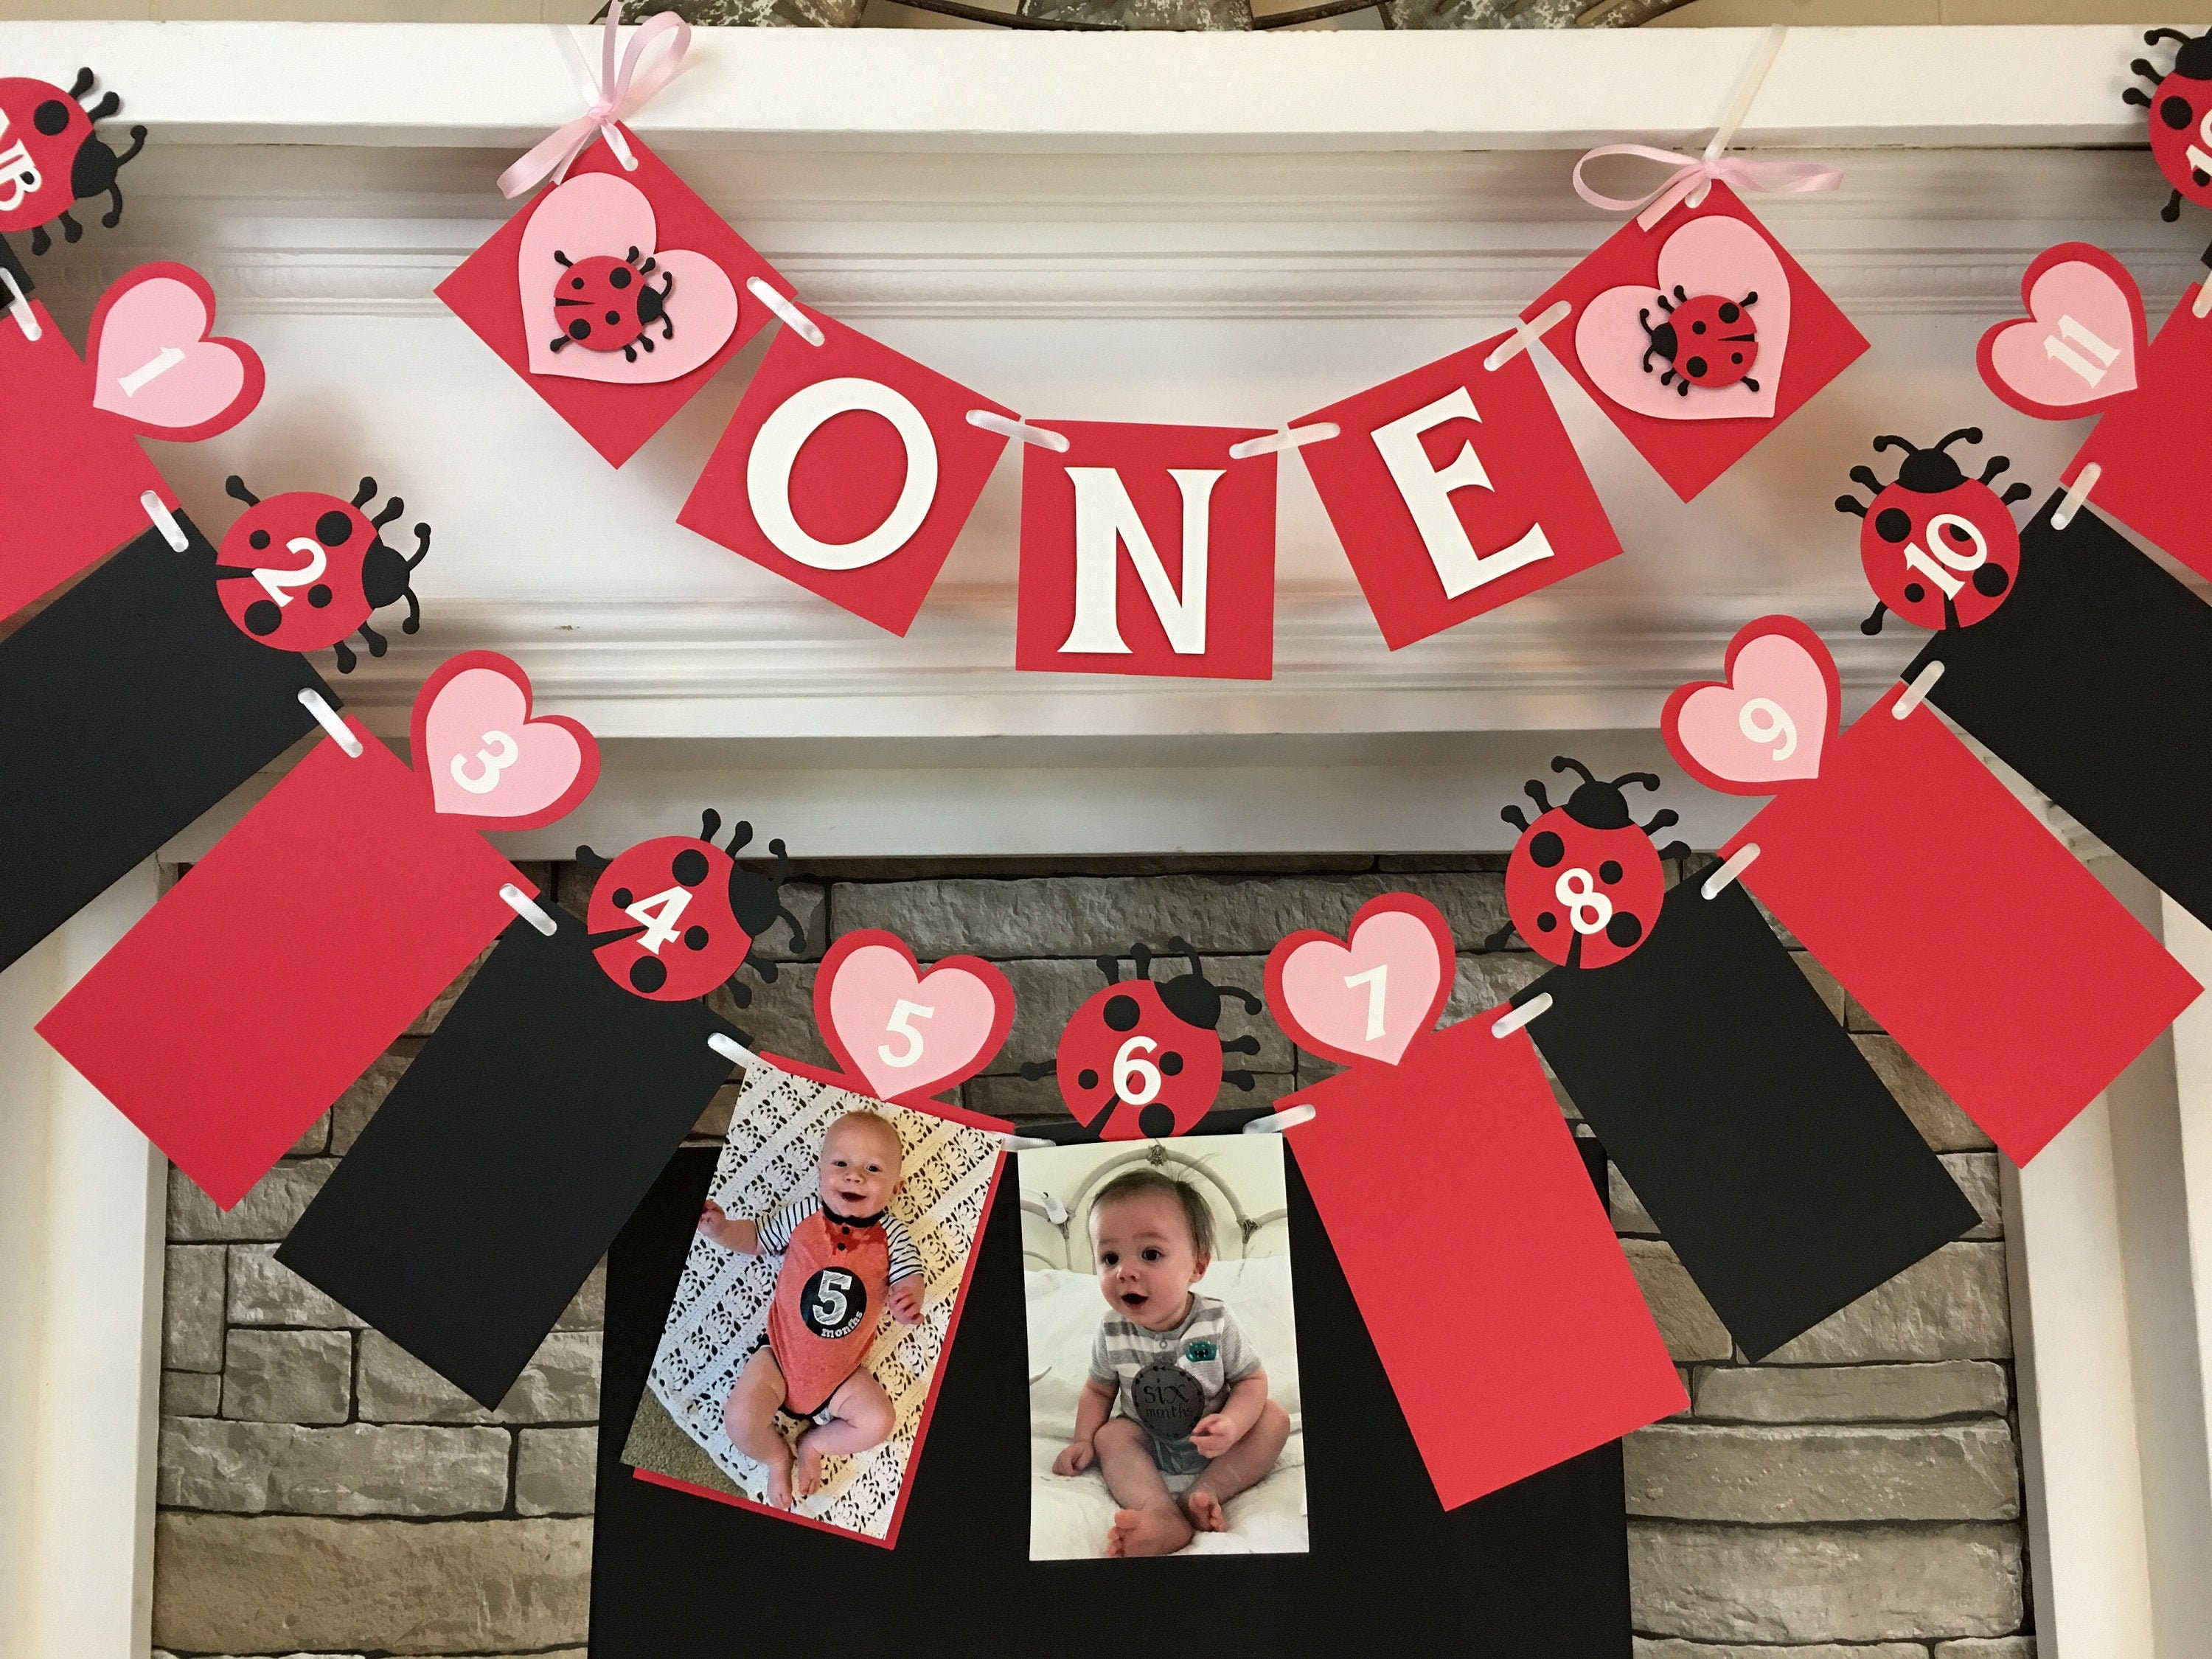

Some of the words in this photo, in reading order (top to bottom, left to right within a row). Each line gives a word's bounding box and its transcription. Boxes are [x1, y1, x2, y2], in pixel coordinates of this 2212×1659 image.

[117, 347, 185, 398] 1
[2043, 314, 2121, 389] 11
[251, 537, 327, 608] 2
[1903, 513, 1987, 600] 10
[451, 730, 518, 794] 3
[1739, 698, 1798, 761] 9
[625, 886, 693, 956] 4
[1555, 868, 1613, 935] 8
[877, 998, 935, 1068] 5
[1343, 964, 1388, 1041] 7
[1113, 1035, 1162, 1105] 6
[812, 1270, 852, 1326] 5
[821, 1311, 863, 1338] months
[1144, 1377, 1190, 1405] six
[1145, 1406, 1194, 1419] months
